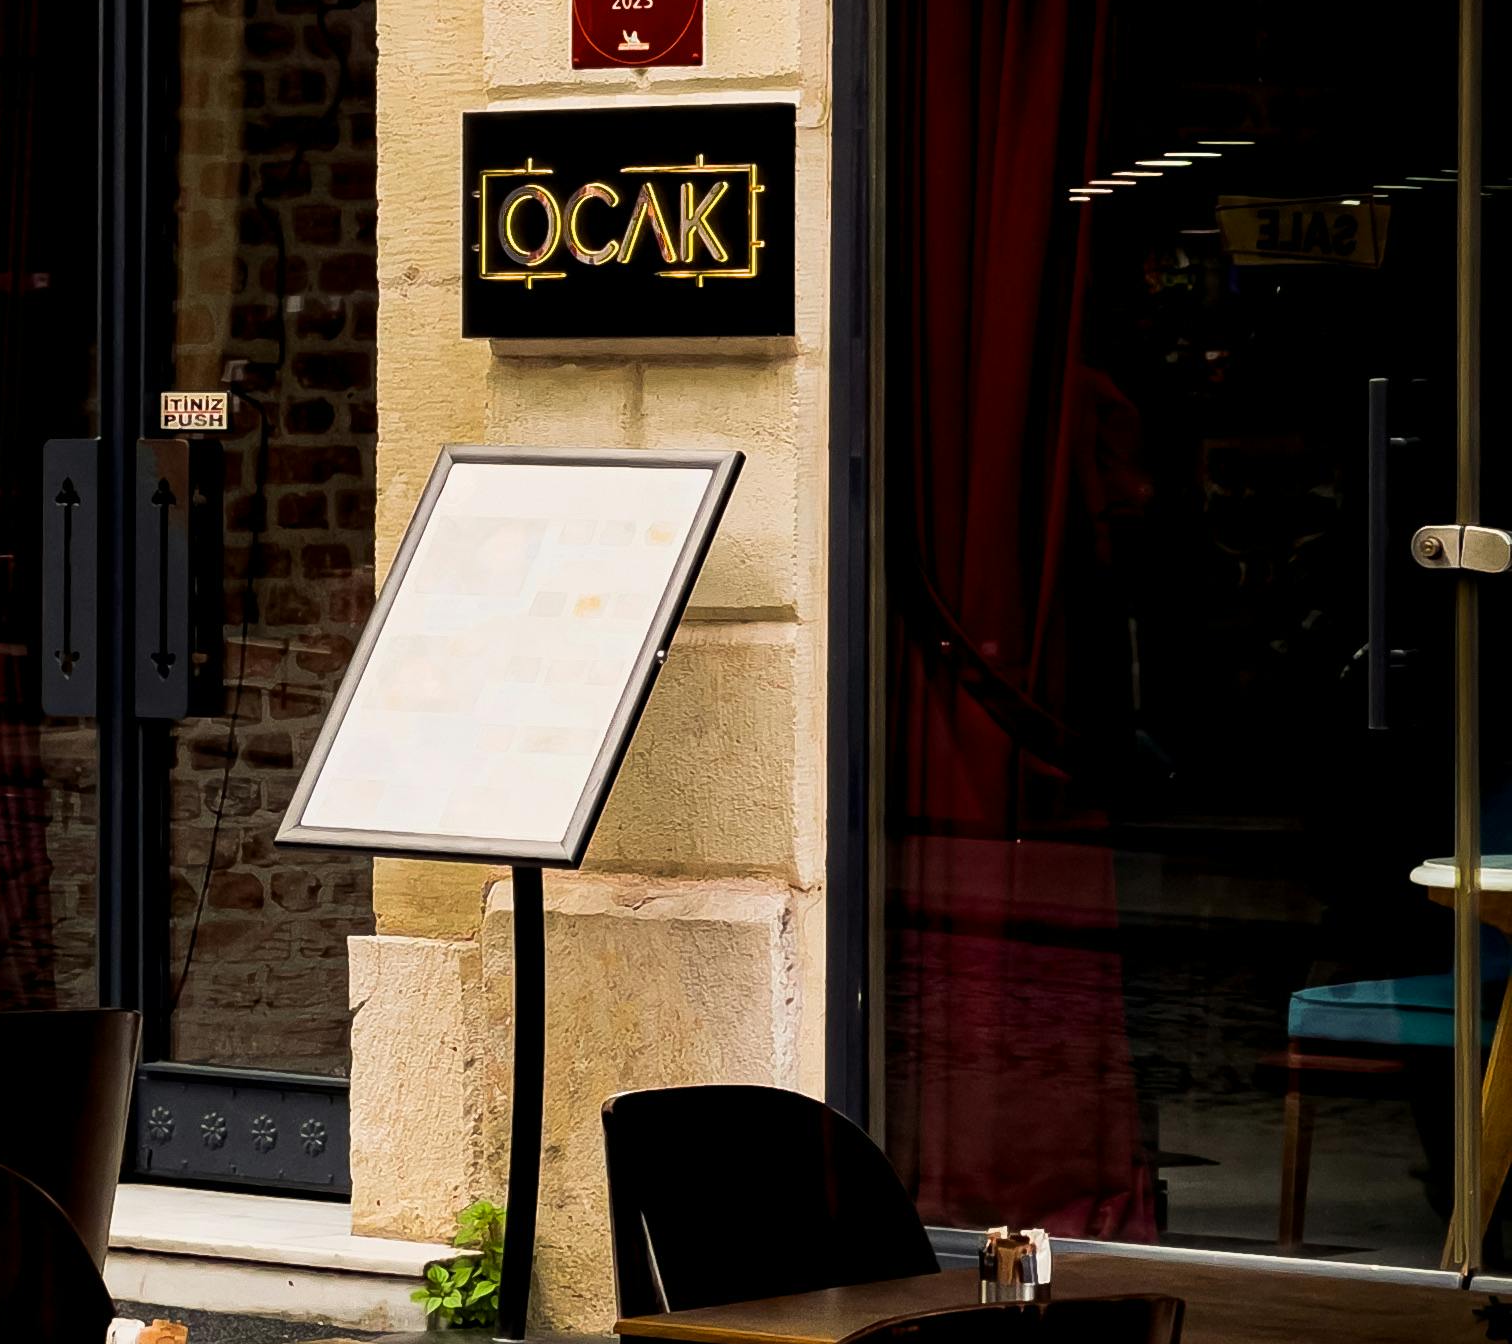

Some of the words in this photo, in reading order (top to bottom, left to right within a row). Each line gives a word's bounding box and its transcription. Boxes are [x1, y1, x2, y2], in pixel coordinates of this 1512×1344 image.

[498, 181, 728, 266] OCAK
[164, 395, 223, 411] İTİNİZ
[163, 414, 223, 427] PUSH
